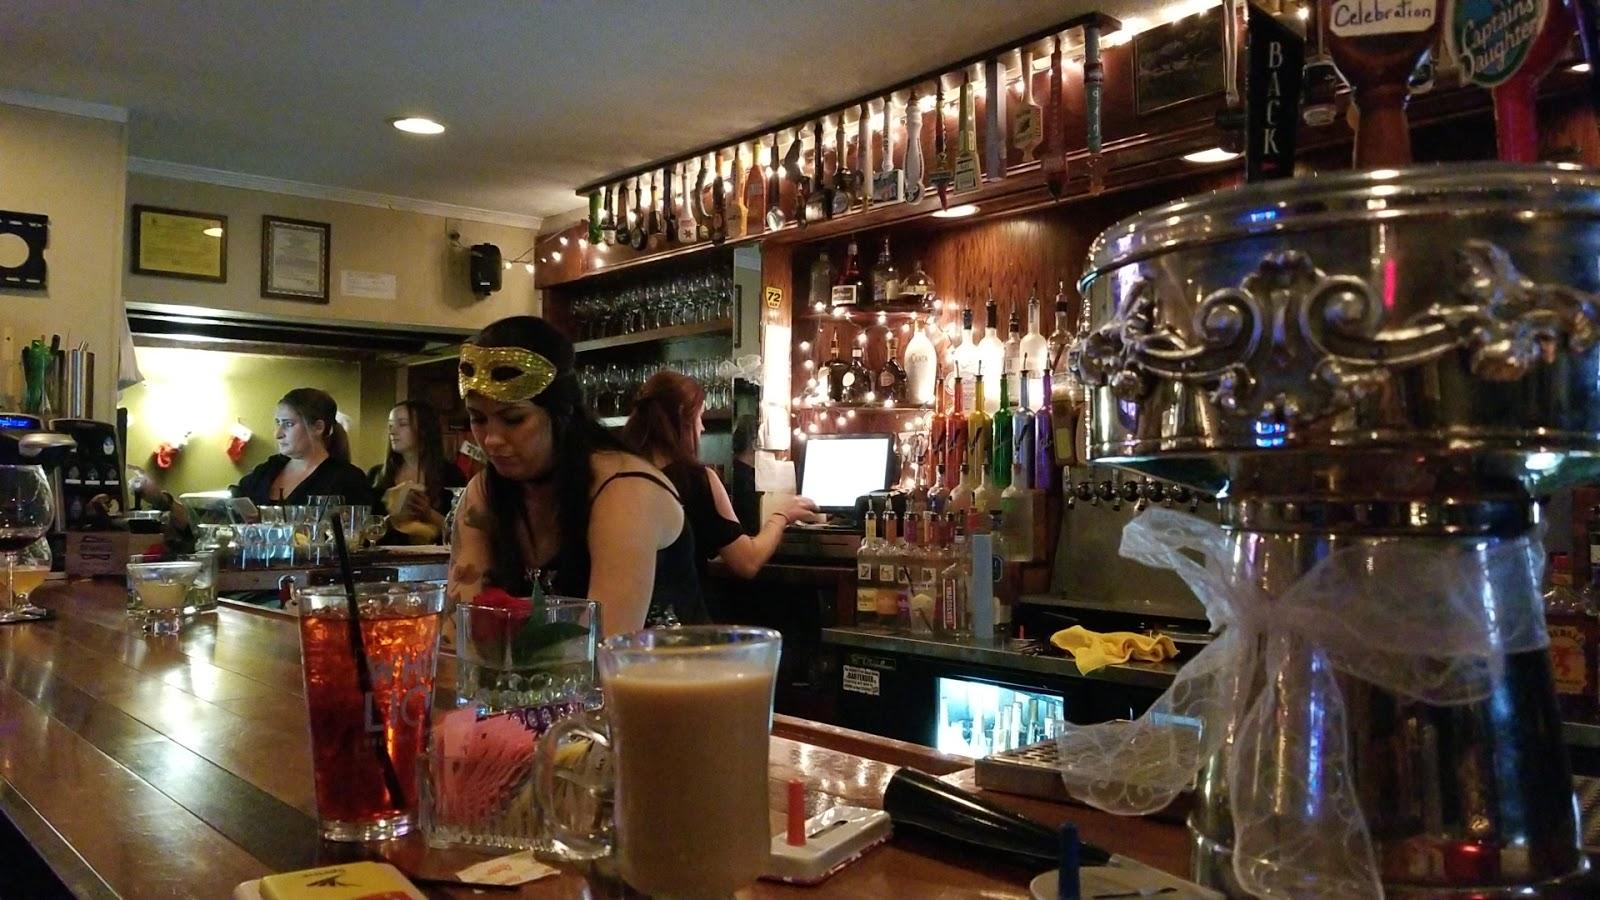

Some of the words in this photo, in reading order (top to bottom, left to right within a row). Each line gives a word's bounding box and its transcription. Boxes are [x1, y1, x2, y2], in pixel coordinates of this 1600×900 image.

[1334, 0, 1432, 27] Celebration
[1263, 41, 1284, 156] BACK
[767, 291, 781, 303] 72
